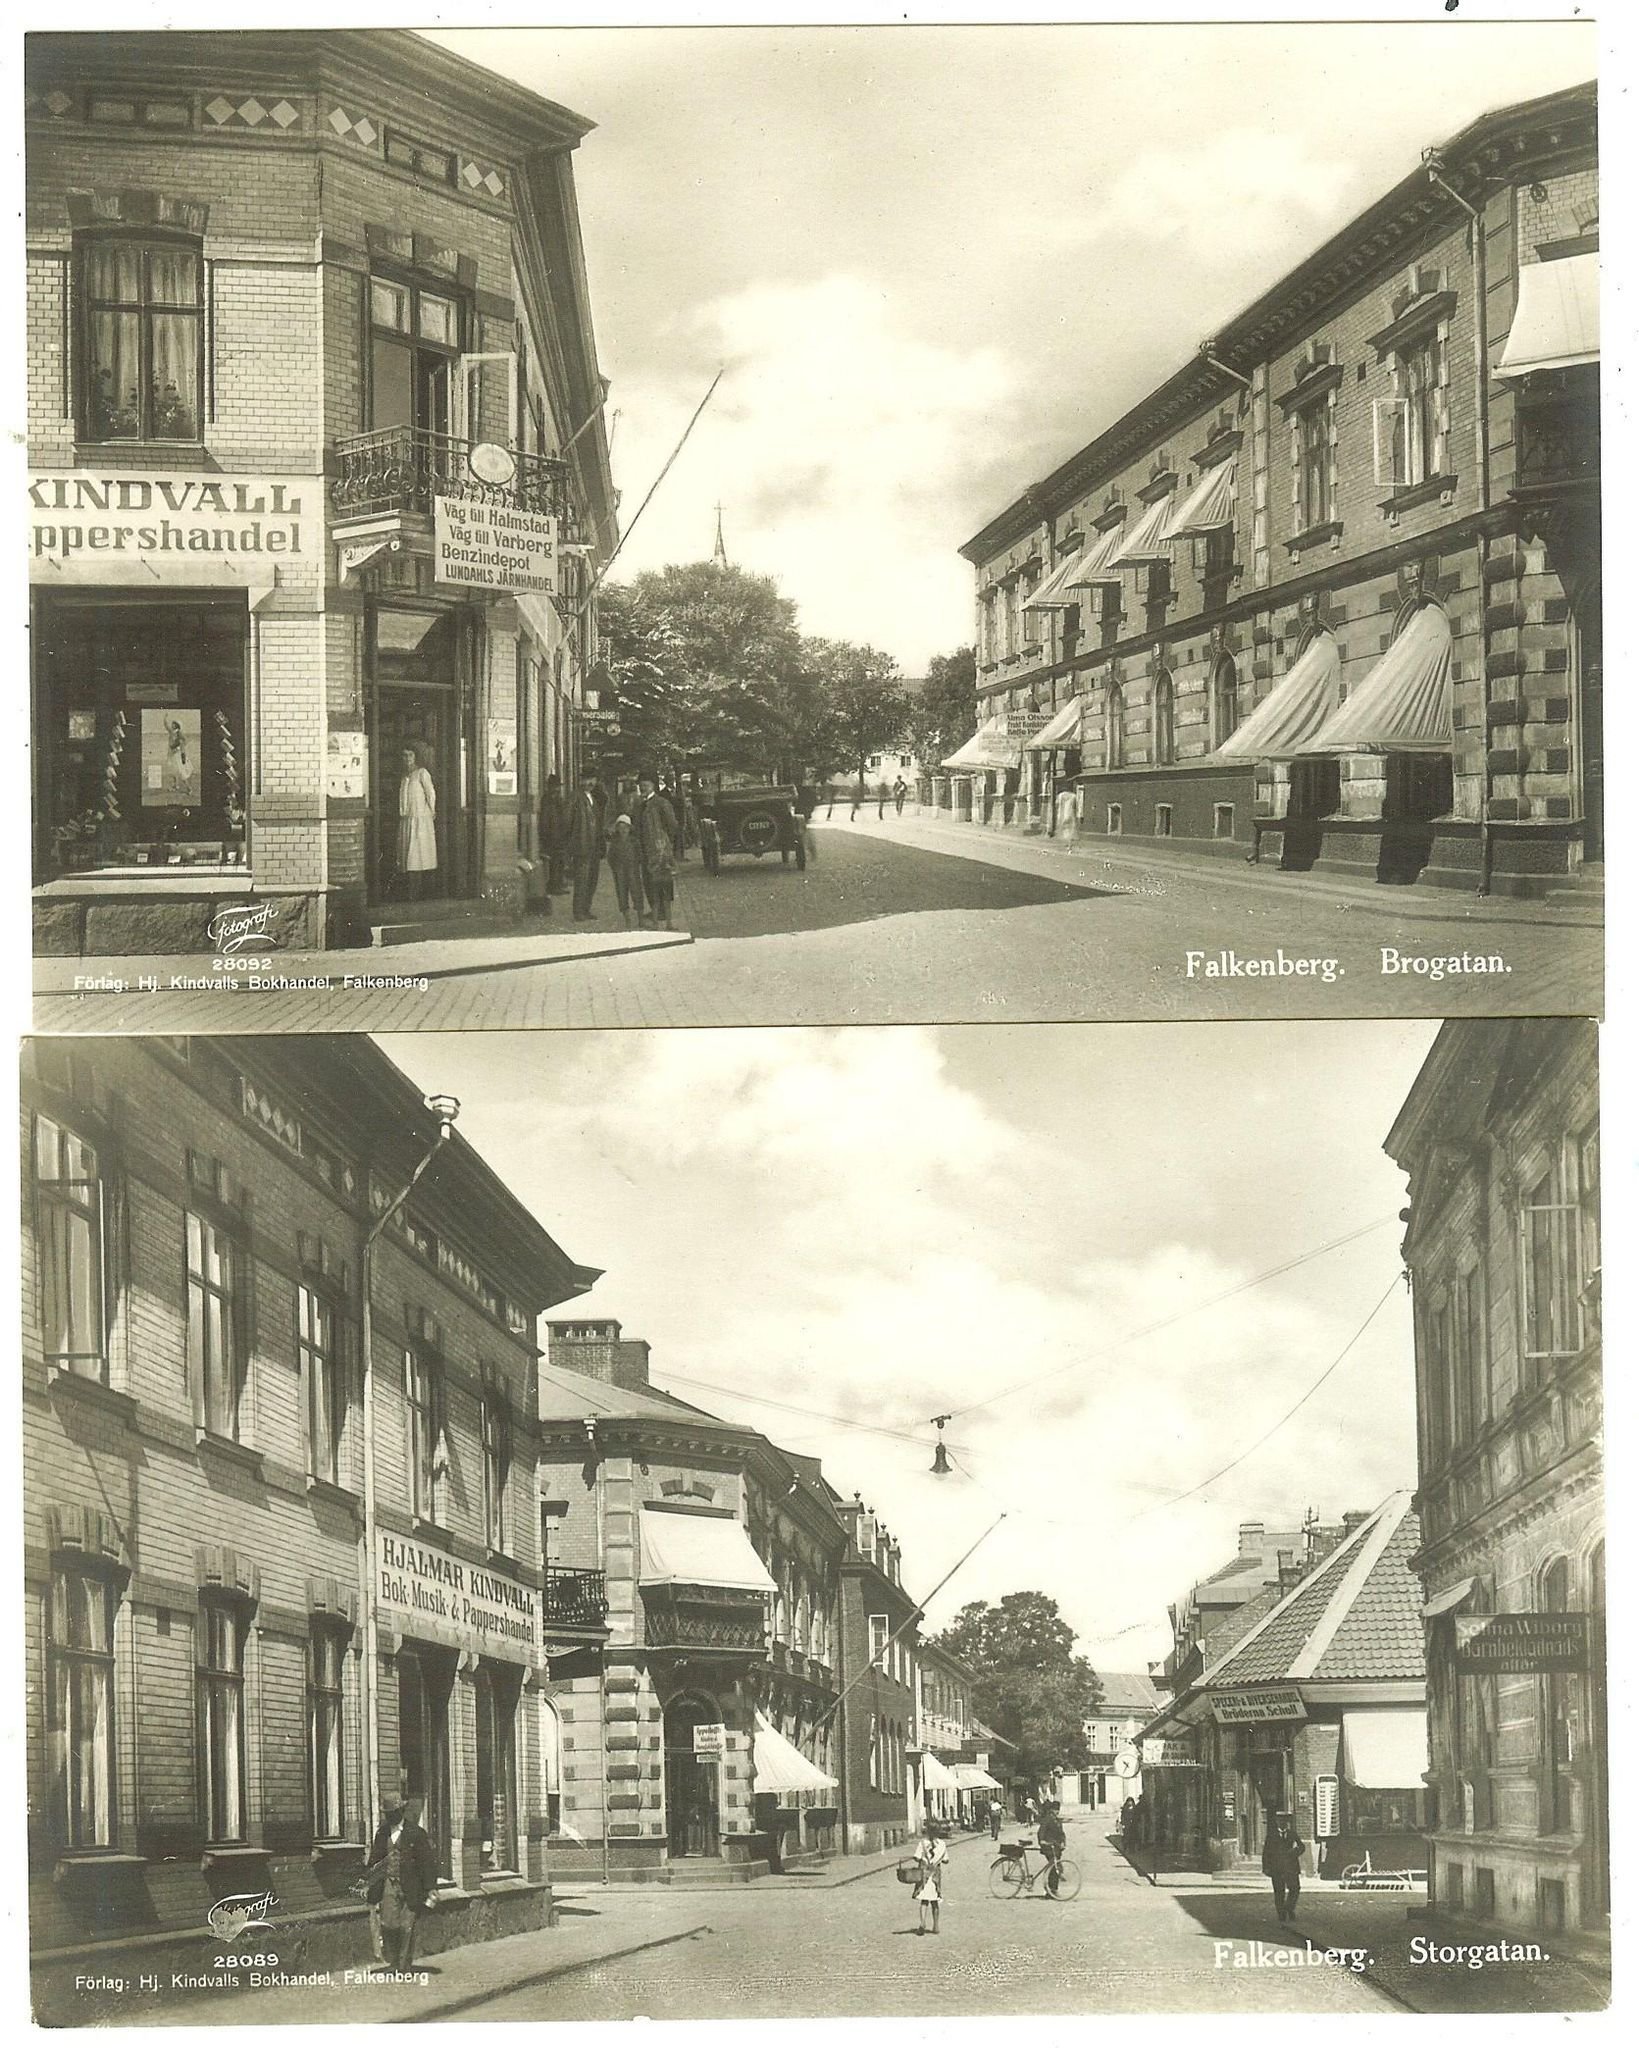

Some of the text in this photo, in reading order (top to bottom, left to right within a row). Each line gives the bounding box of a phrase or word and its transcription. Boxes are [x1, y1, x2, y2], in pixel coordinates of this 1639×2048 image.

[444, 503, 550, 535] Väg till Halmstad
[29, 520, 301, 557] ppershandel
[450, 525, 552, 558] Väg till Varberg
[442, 543, 530, 571] Benzindepot
[445, 563, 554, 592] LUNDAHLS JÄRNHANDEL
[382, 1537, 534, 1616] HJALMAR KINDVALL
[451, 1593, 460, 1621] &
[463, 1597, 535, 1644] Pappershandel
[1516, 1619, 1582, 1637] Wiborg
[1221, 1707, 1266, 1719] Bröderna
